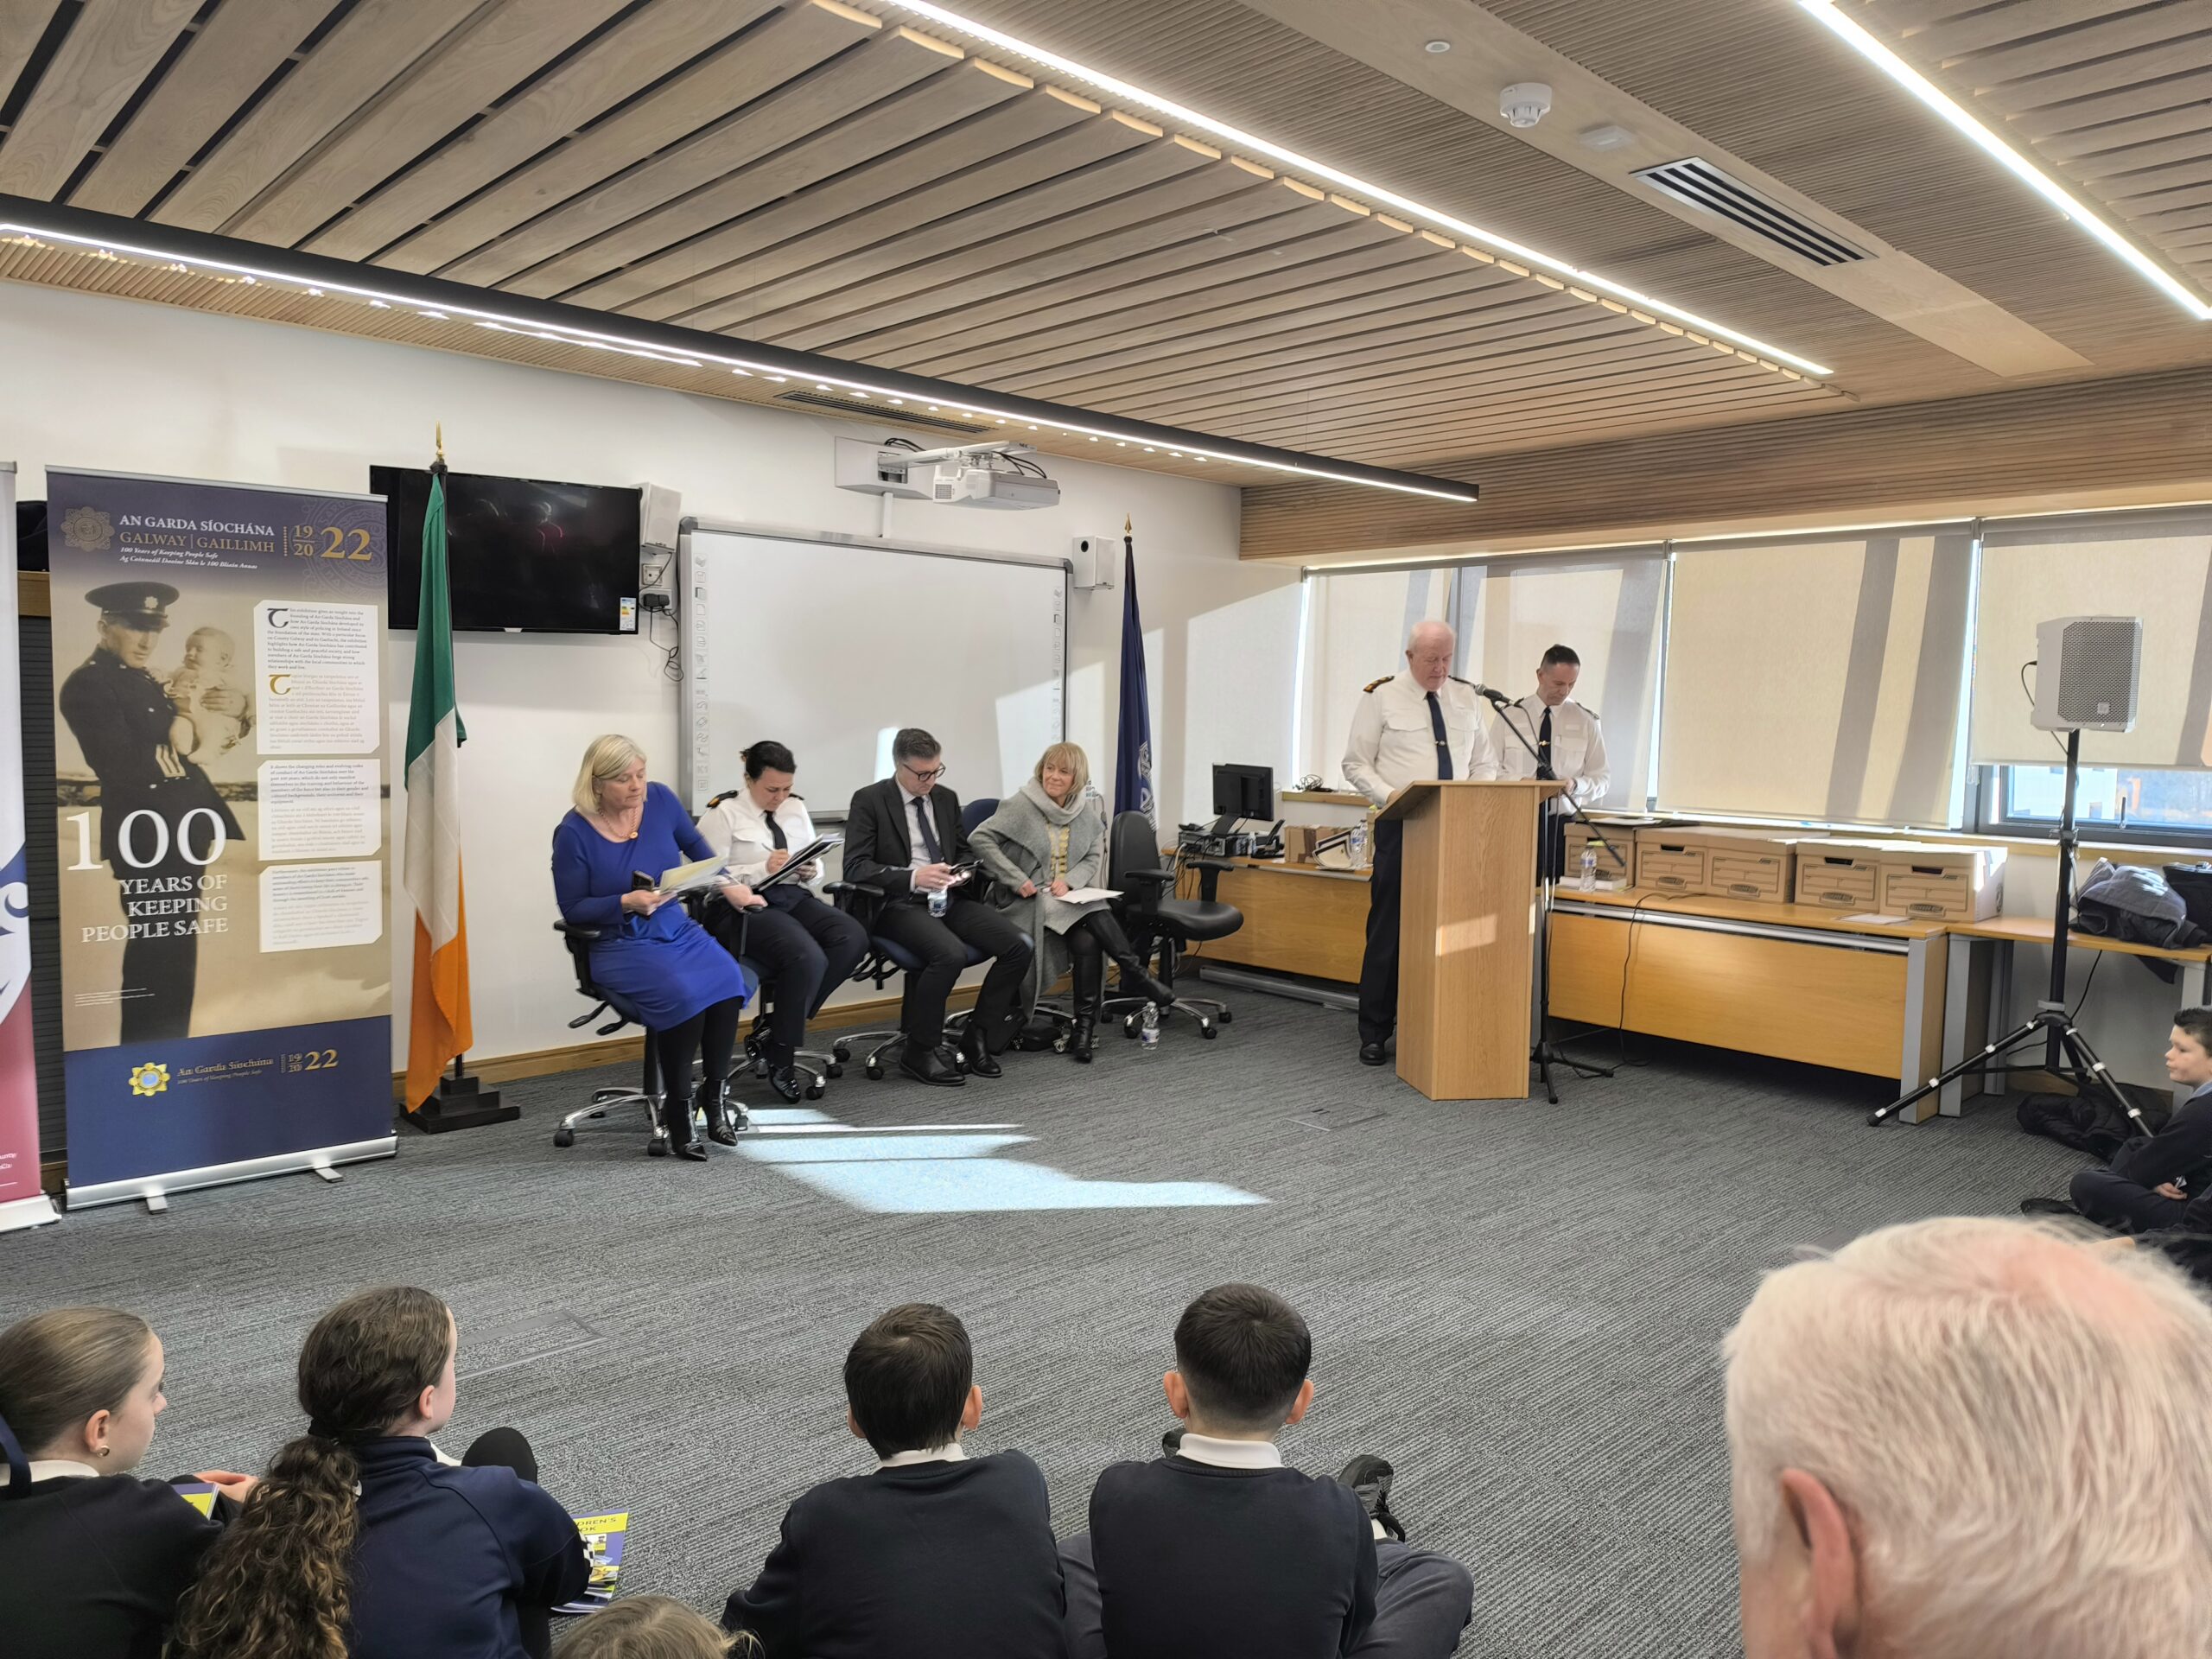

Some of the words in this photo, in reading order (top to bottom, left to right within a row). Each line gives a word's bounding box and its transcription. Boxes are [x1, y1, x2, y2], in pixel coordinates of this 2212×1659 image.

[119, 515, 142, 526] AN
[145, 517, 197, 531] GARDA
[200, 520, 275, 536] SÍOCHÁNA
[294, 525, 313, 538] 19
[120, 532, 187, 547] GALWAY
[197, 537, 275, 553] GAILLIMH
[294, 543, 314, 556] 20
[320, 527, 373, 561] 22
[66, 807, 227, 871] 100
[119, 875, 193, 895] YEARS
[197, 874, 228, 891] OF
[127, 896, 228, 917] KEEPING
[81, 921, 170, 943] PEOPLE
[174, 918, 229, 936] SAFE
[195, 1062, 228, 1074] Garda
[304, 1049, 338, 1071] 22
[577, 1517, 616, 1526] DREN'S
